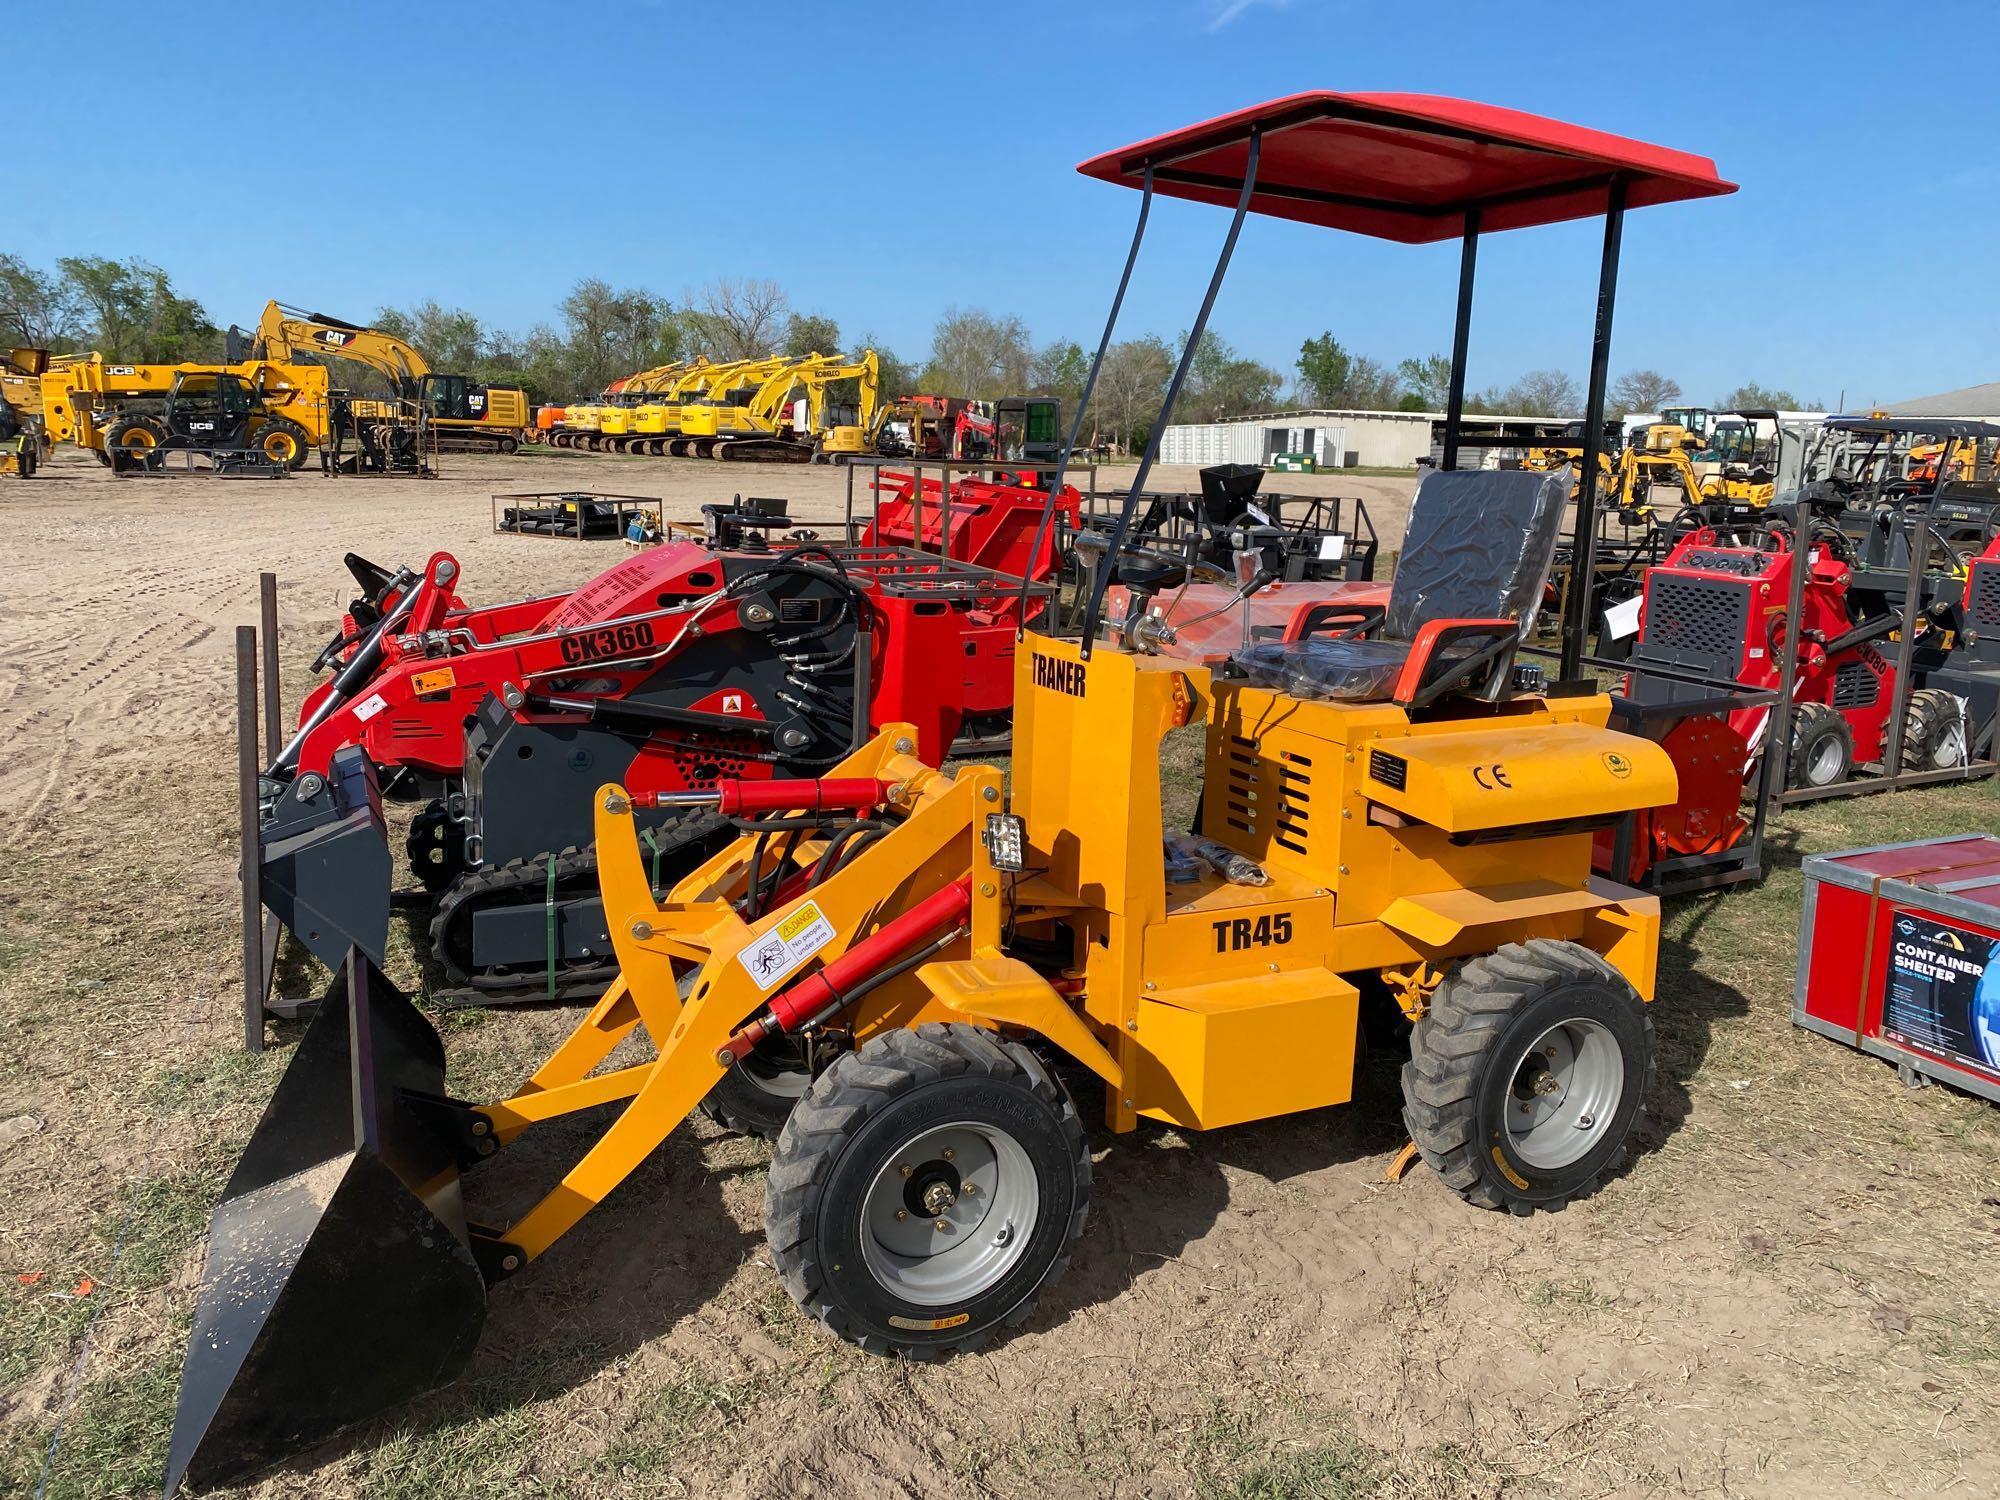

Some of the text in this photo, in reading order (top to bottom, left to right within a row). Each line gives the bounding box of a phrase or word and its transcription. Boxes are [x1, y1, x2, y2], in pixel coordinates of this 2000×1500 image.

[326, 330, 345, 346] CAT
[105, 367, 135, 375] JCB
[815, 370, 840, 378] KOBELCO
[468, 394, 484, 405] CAT
[189, 422, 214, 430] JCB
[560, 621, 654, 664] CK360
[1856, 641, 1887, 675] CK380
[1032, 652, 1086, 698] TRANER
[792, 908, 814, 930] DANGER
[791, 924, 822, 948] No people
[797, 931, 827, 956] under arm
[1213, 912, 1292, 953] TR45
[1894, 955, 1956, 984] SHELTER
[1896, 942, 1984, 977] CONTAINER
